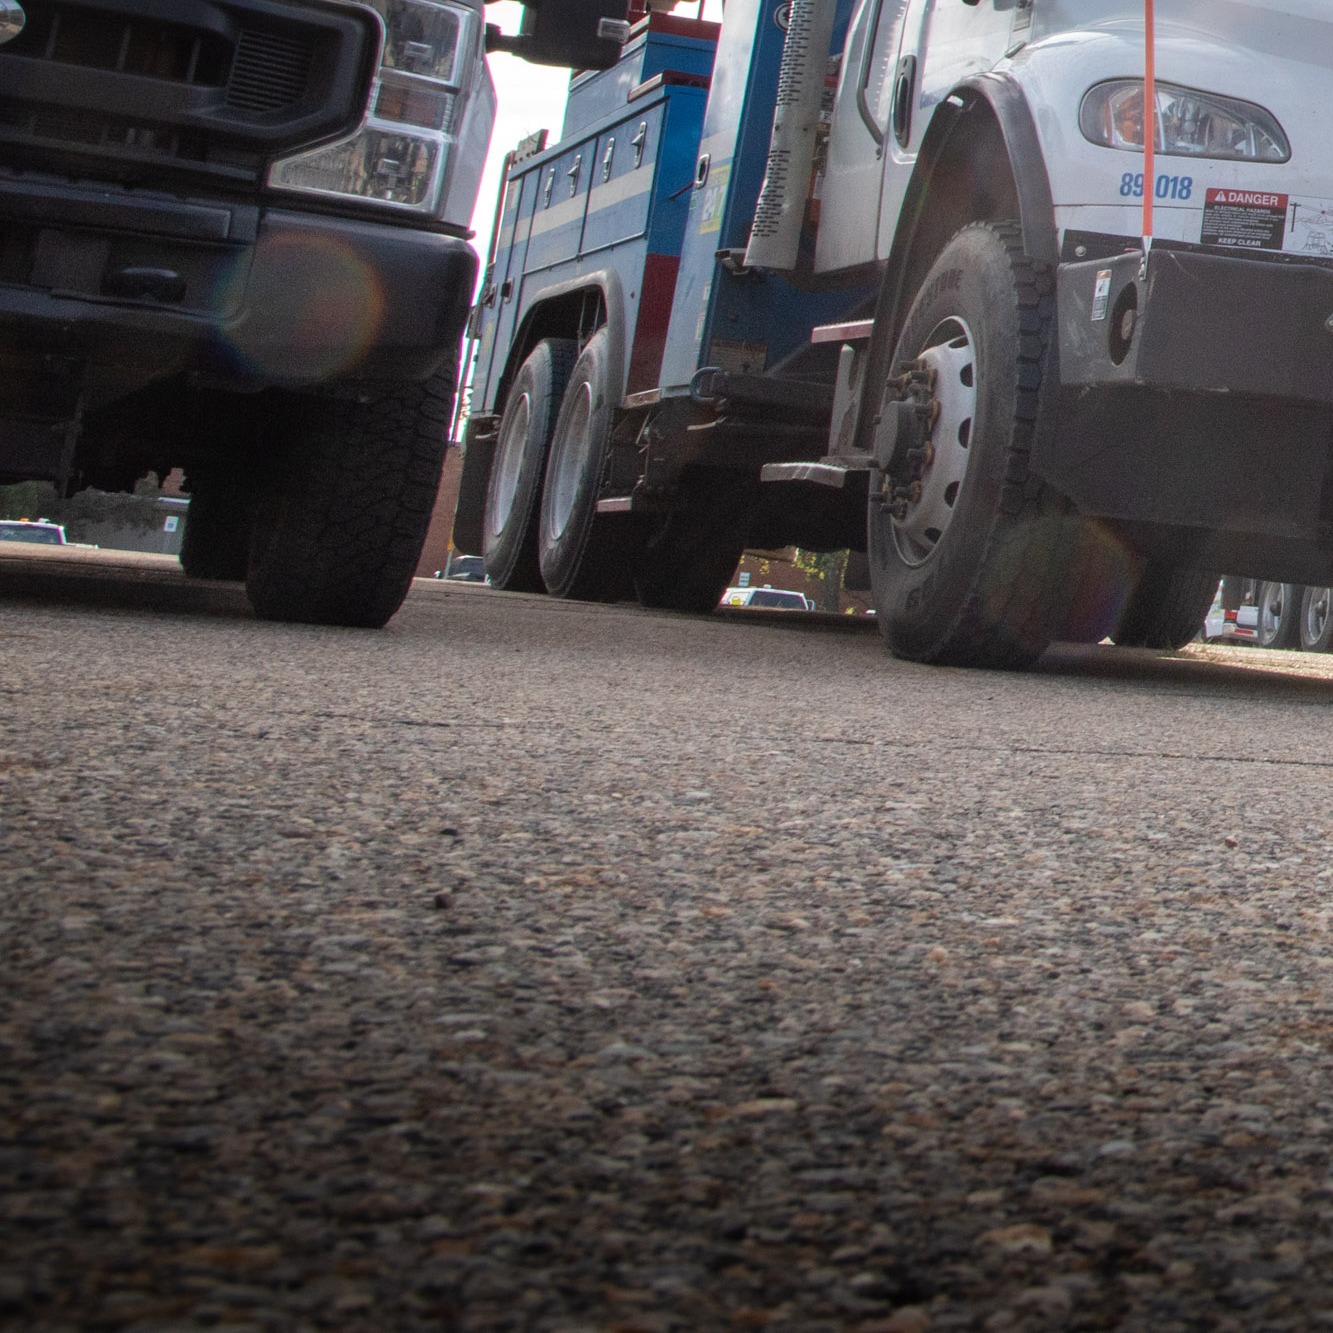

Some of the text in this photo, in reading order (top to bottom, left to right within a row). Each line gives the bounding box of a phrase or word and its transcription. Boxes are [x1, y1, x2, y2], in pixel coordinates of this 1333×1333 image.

[1228, 192, 1279, 206] DANGER
[1214, 205, 1245, 213] ELECTRICAL
[1237, 239, 1261, 247] CLEAR
